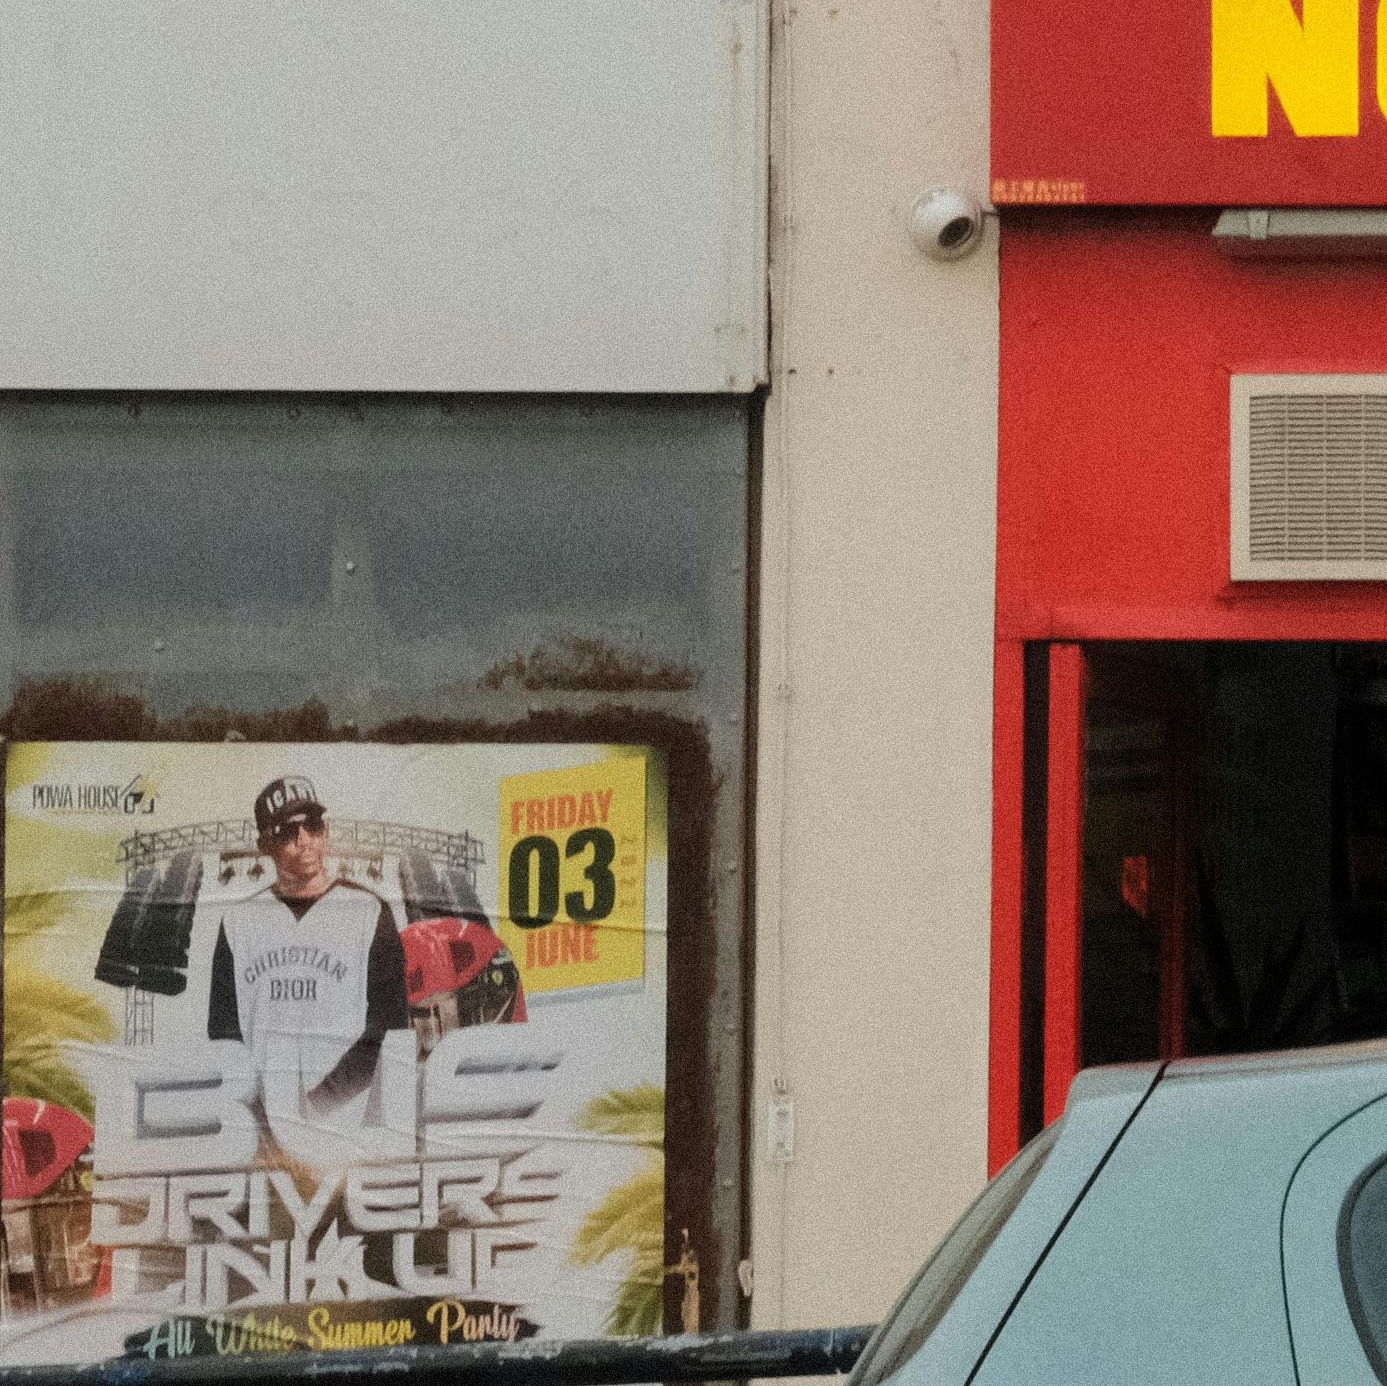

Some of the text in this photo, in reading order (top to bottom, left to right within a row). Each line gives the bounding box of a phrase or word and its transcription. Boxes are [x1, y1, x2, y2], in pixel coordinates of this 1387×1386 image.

[31, 782, 75, 811] POWA
[510, 787, 615, 837] FRIDAY
[507, 826, 618, 931] 03
[243, 945, 350, 985] CHRISTIAN
[525, 923, 600, 971] JUNE
[268, 976, 319, 1003] DIOR
[91, 1157, 570, 1246] DRIVERS
[205, 1312, 297, 1357] White
[307, 1307, 417, 1352] Summer
[426, 1298, 520, 1346] Party
